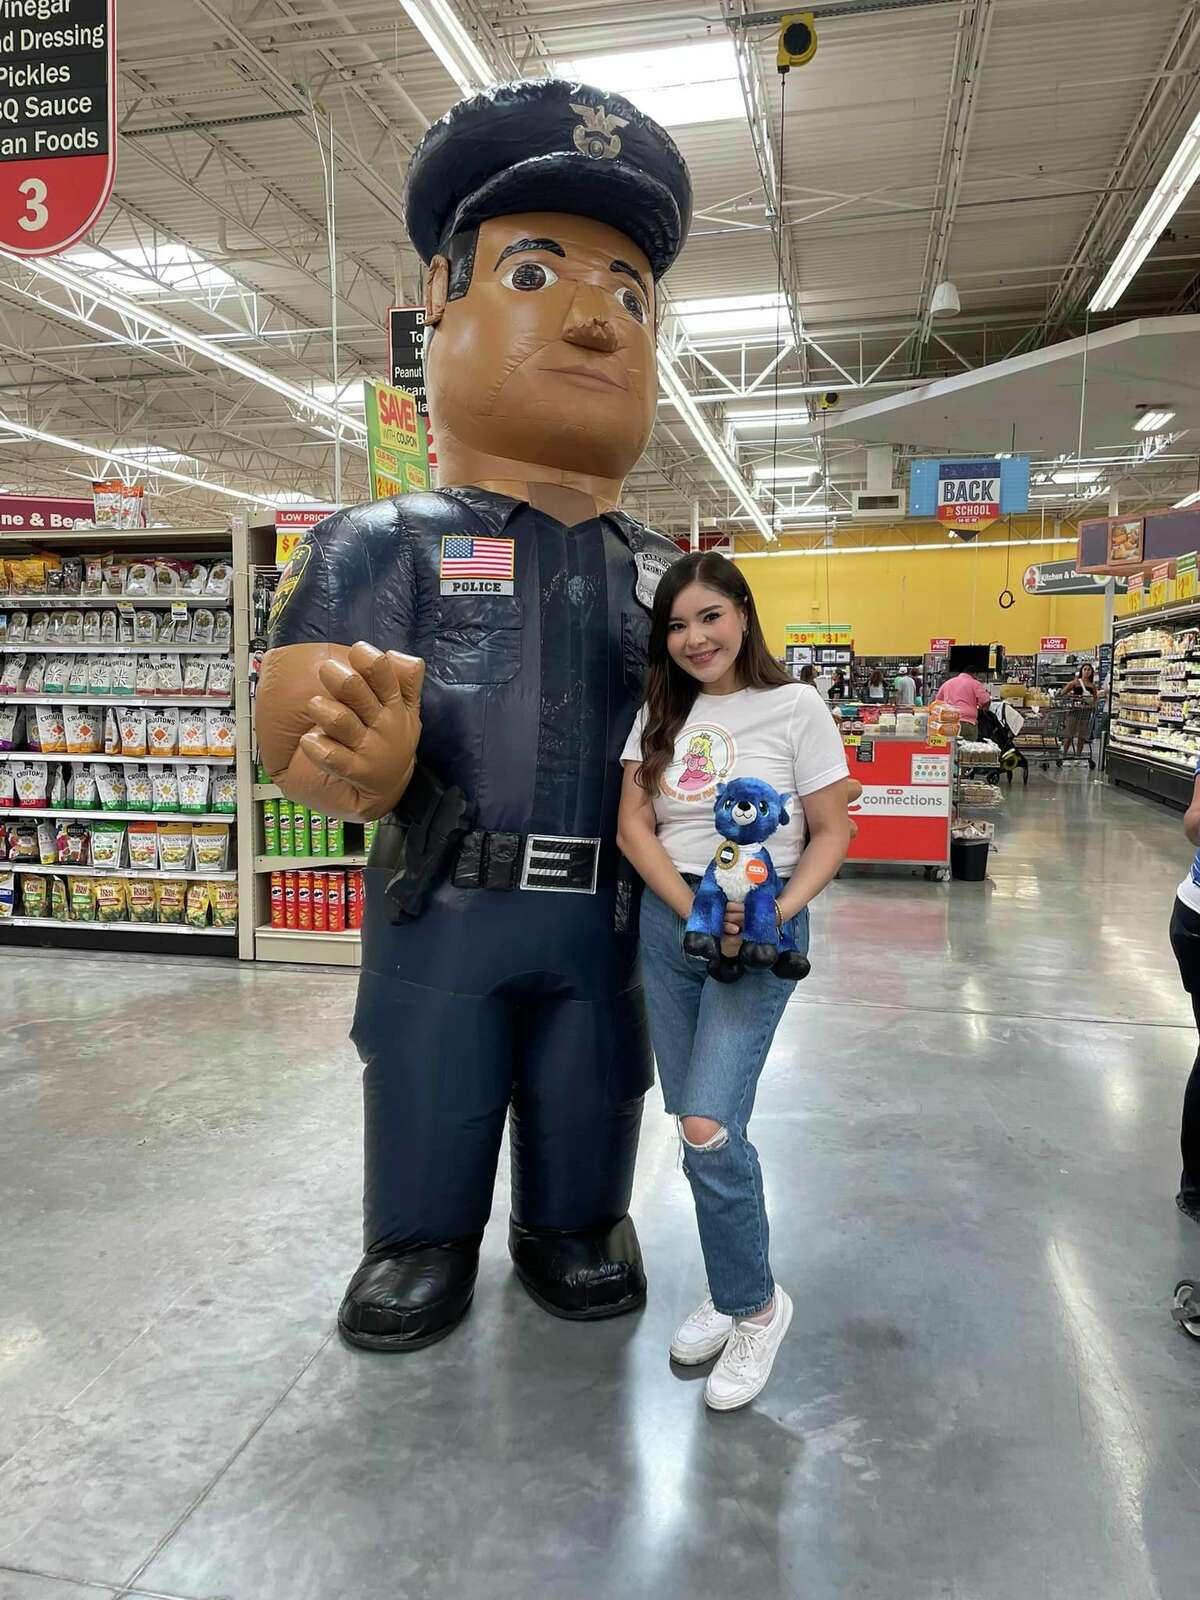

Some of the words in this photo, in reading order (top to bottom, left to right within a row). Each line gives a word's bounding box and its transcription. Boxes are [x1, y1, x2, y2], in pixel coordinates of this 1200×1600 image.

[0, 0, 71, 20] inegar
[0, 30, 14, 53] d
[20, 24, 105, 50] Dressing
[0, 98, 18, 123] Q
[25, 95, 92, 119] Sauce
[1, 138, 27, 155] an
[34, 127, 99, 153] Foods
[17, 177, 49, 232] 3
[394, 366, 423, 379] Peanut
[378, 389, 417, 434] SAVE!
[396, 431, 417, 448] COUPON
[943, 479, 994, 502] BACK
[281, 513, 302, 521] LOW
[955, 504, 992, 516] SCHOOL
[29, 513, 45, 527] &
[452, 582, 502, 592] POLICE
[862, 795, 943, 806] connections
